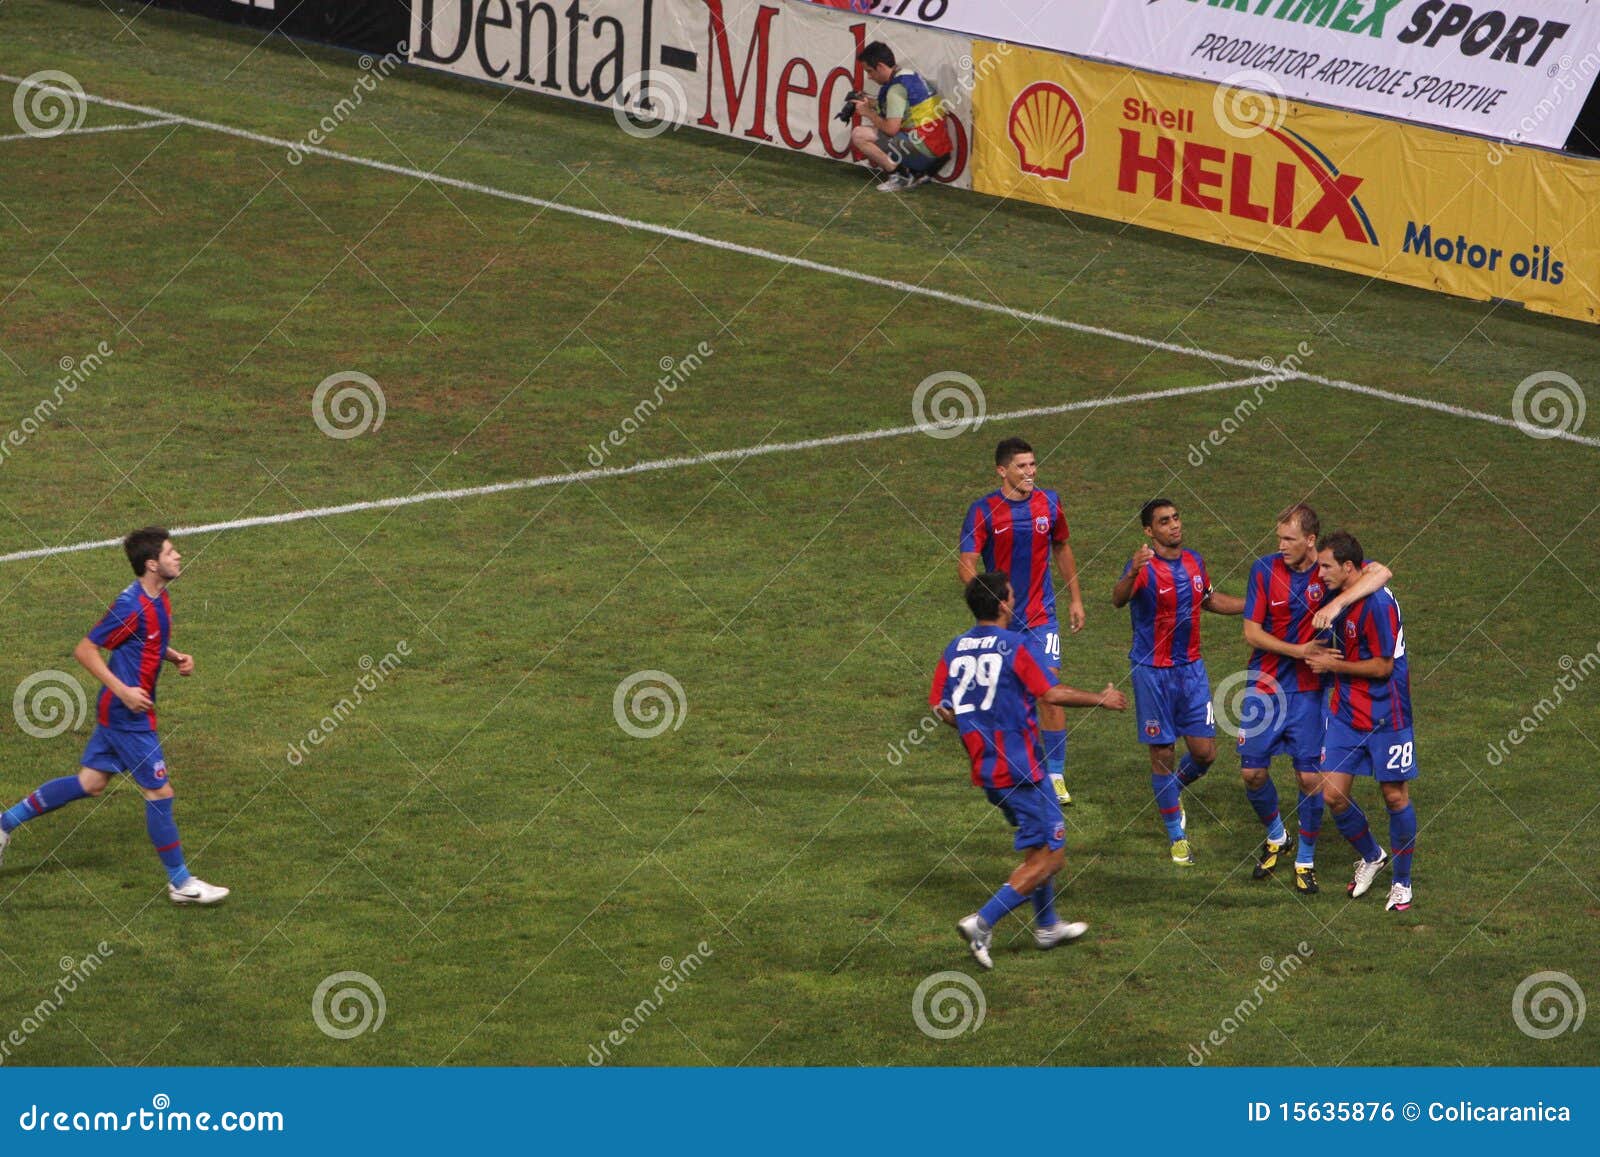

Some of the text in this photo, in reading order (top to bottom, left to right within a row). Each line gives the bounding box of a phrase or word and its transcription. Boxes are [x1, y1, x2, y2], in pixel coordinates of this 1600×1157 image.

[1396, 0, 1571, 67] SPORT
[1191, 33, 1508, 114] PRODUCATOR ARTICOLE SPORTIVE
[1123, 98, 1194, 133] Shell
[1118, 127, 1369, 244] HELIX
[1403, 221, 1565, 285] Motor oils
[1045, 632, 1060, 655] 10
[949, 653, 1003, 715] 29
[1387, 741, 1413, 769] 28
